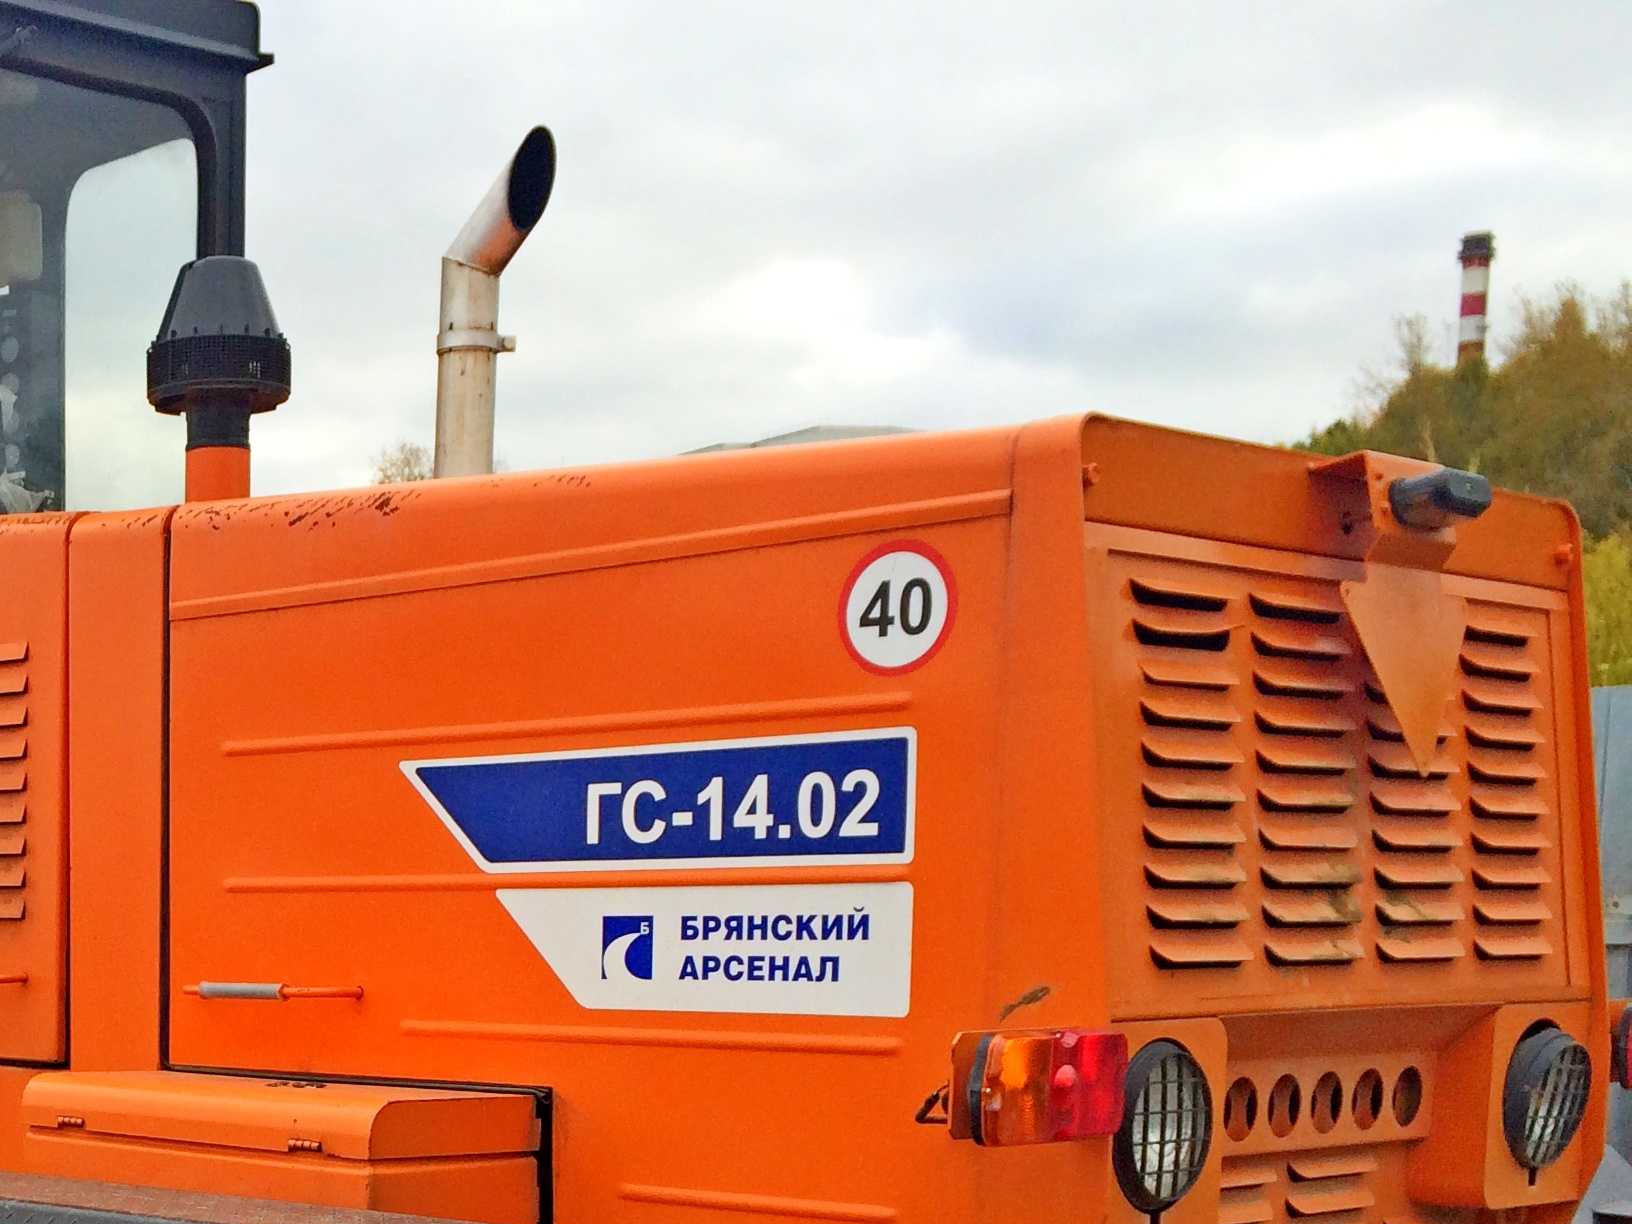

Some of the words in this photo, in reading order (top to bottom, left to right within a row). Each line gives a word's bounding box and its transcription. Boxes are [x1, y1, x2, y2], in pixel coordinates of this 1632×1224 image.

[858, 577, 933, 637] 40
[587, 769, 879, 844] ГС-14.02
[680, 906, 870, 941] БРЯНСКИЙ
[679, 956, 839, 982] АРСЕНАЛ
